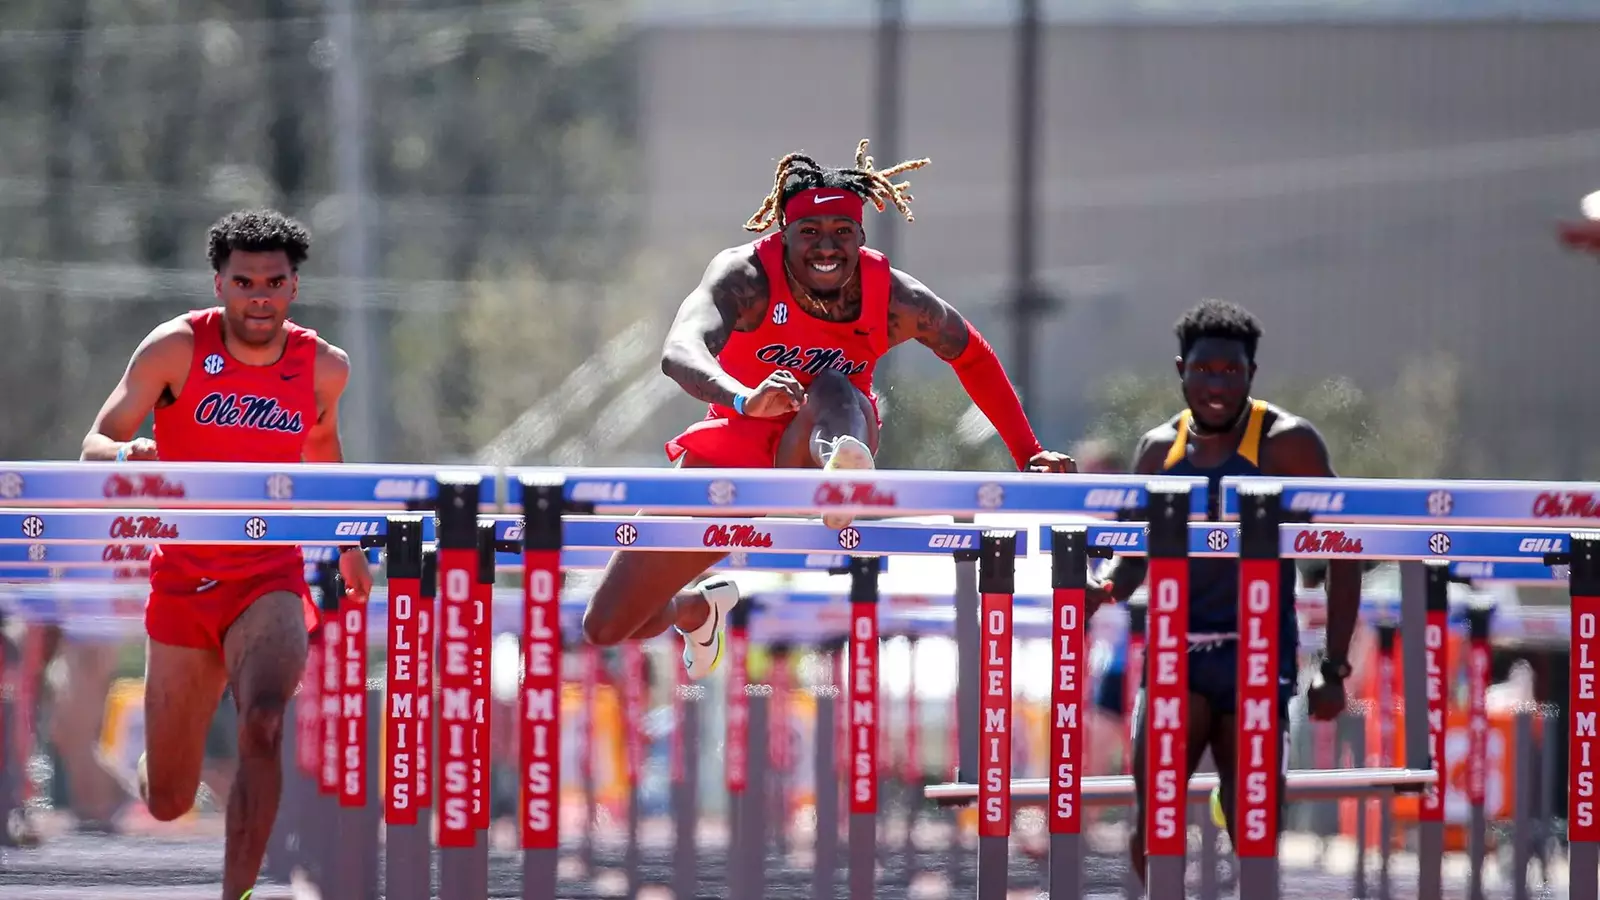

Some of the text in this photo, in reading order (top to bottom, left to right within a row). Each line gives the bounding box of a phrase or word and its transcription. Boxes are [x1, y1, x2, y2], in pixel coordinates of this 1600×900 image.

[203, 354, 225, 375] SEC
[756, 344, 802, 369] Ole
[194, 392, 302, 433] Ole Miss
[1565, 492, 1600, 517] Mis
[22, 515, 44, 538] SEC
[110, 516, 179, 539] Ole Miss
[245, 516, 267, 539] SEC
[335, 522, 379, 536] GILL
[615, 523, 637, 546] SEC
[703, 524, 773, 547] Ole Miss
[838, 527, 861, 549] SEC
[928, 534, 972, 548] GILL
[1095, 532, 1138, 546] GILL
[1207, 530, 1229, 550] SEC
[1294, 530, 1363, 553] Ole Miss
[1429, 532, 1451, 554] SEC
[1518, 538, 1562, 552] GILL
[123, 545, 150, 561] Mi
[343, 610, 363, 795] OLE MISS
[392, 595, 412, 809] OLE MISS
[442, 568, 471, 830] OLE MISS
[526, 568, 554, 831] OLE MISS
[853, 617, 873, 803] OLE MISS
[1153, 578, 1181, 839] OLE MISS
[1243, 580, 1271, 840] OLE MISS
[985, 610, 1005, 822] OLE MISS
[1057, 605, 1077, 818] OLE MISS
[1576, 613, 1597, 826] OLE MISS
